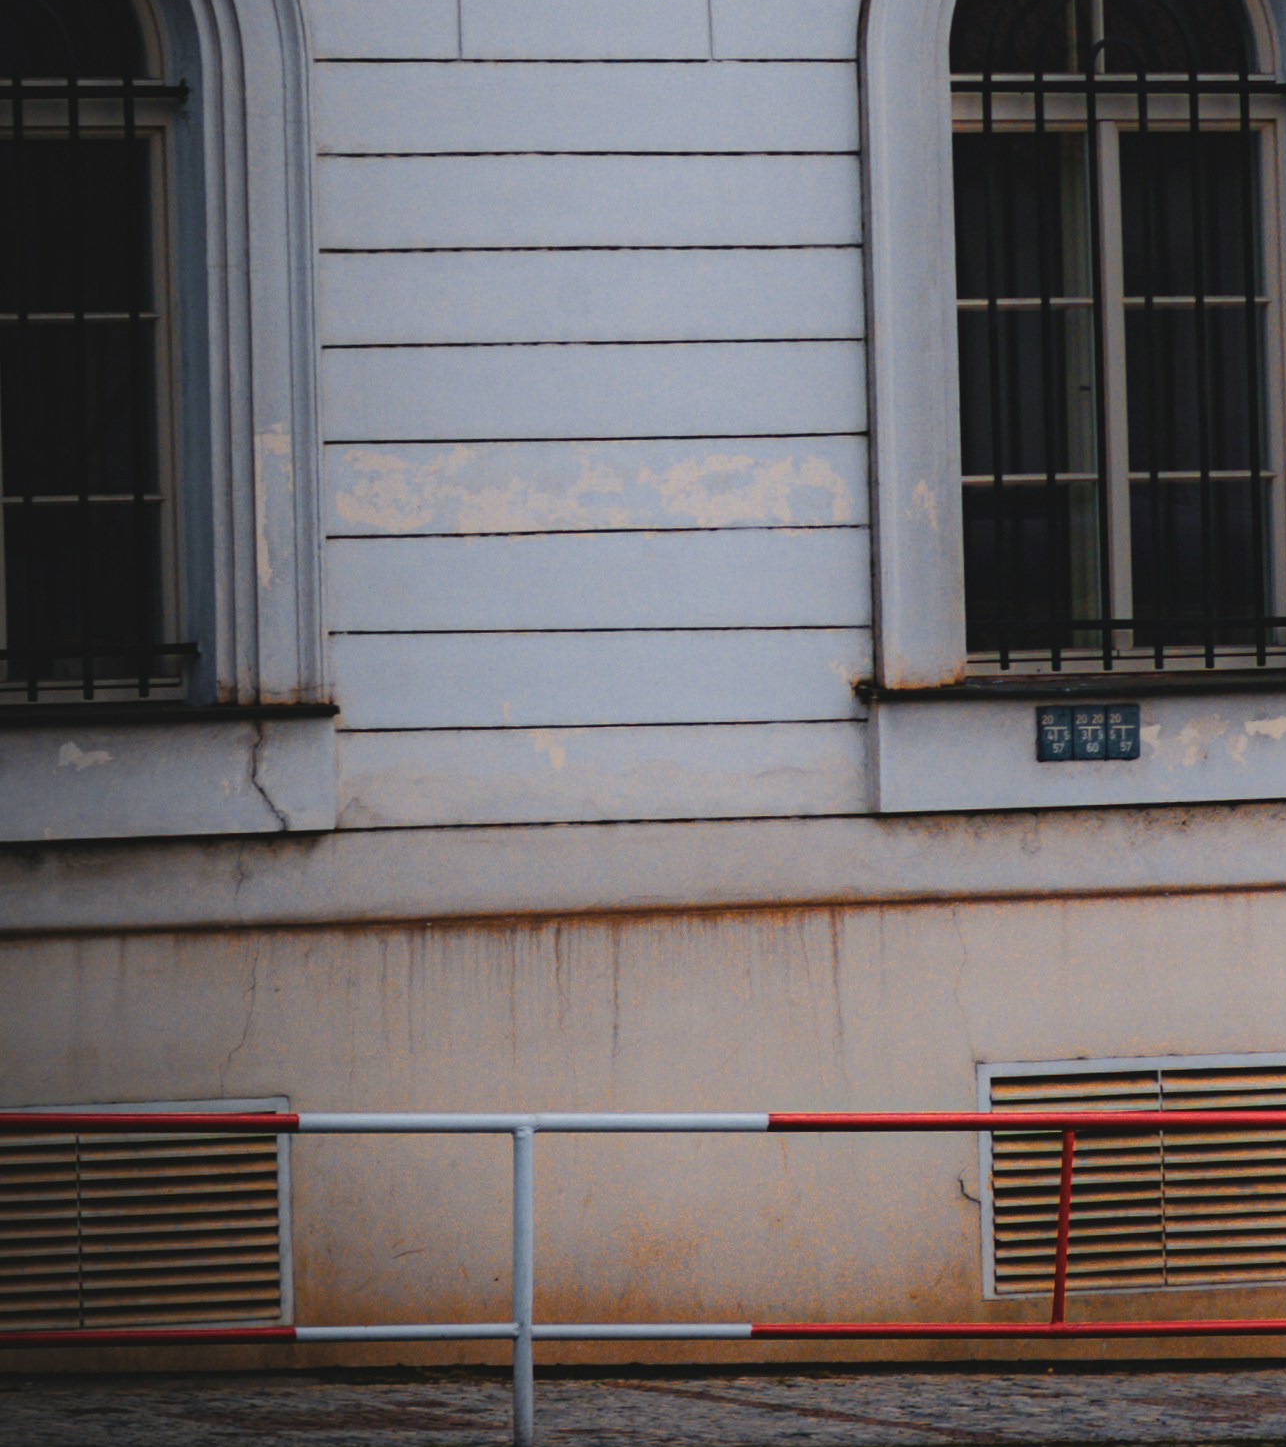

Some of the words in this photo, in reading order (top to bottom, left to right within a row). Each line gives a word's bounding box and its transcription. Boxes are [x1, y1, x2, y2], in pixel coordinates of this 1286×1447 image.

[1042, 714, 1054, 725] 20
[1076, 714, 1088, 724] 20
[1092, 713, 1104, 724] 20
[1110, 713, 1122, 724] 20
[1053, 742, 1065, 753] 57
[1120, 741, 1132, 752] 57
